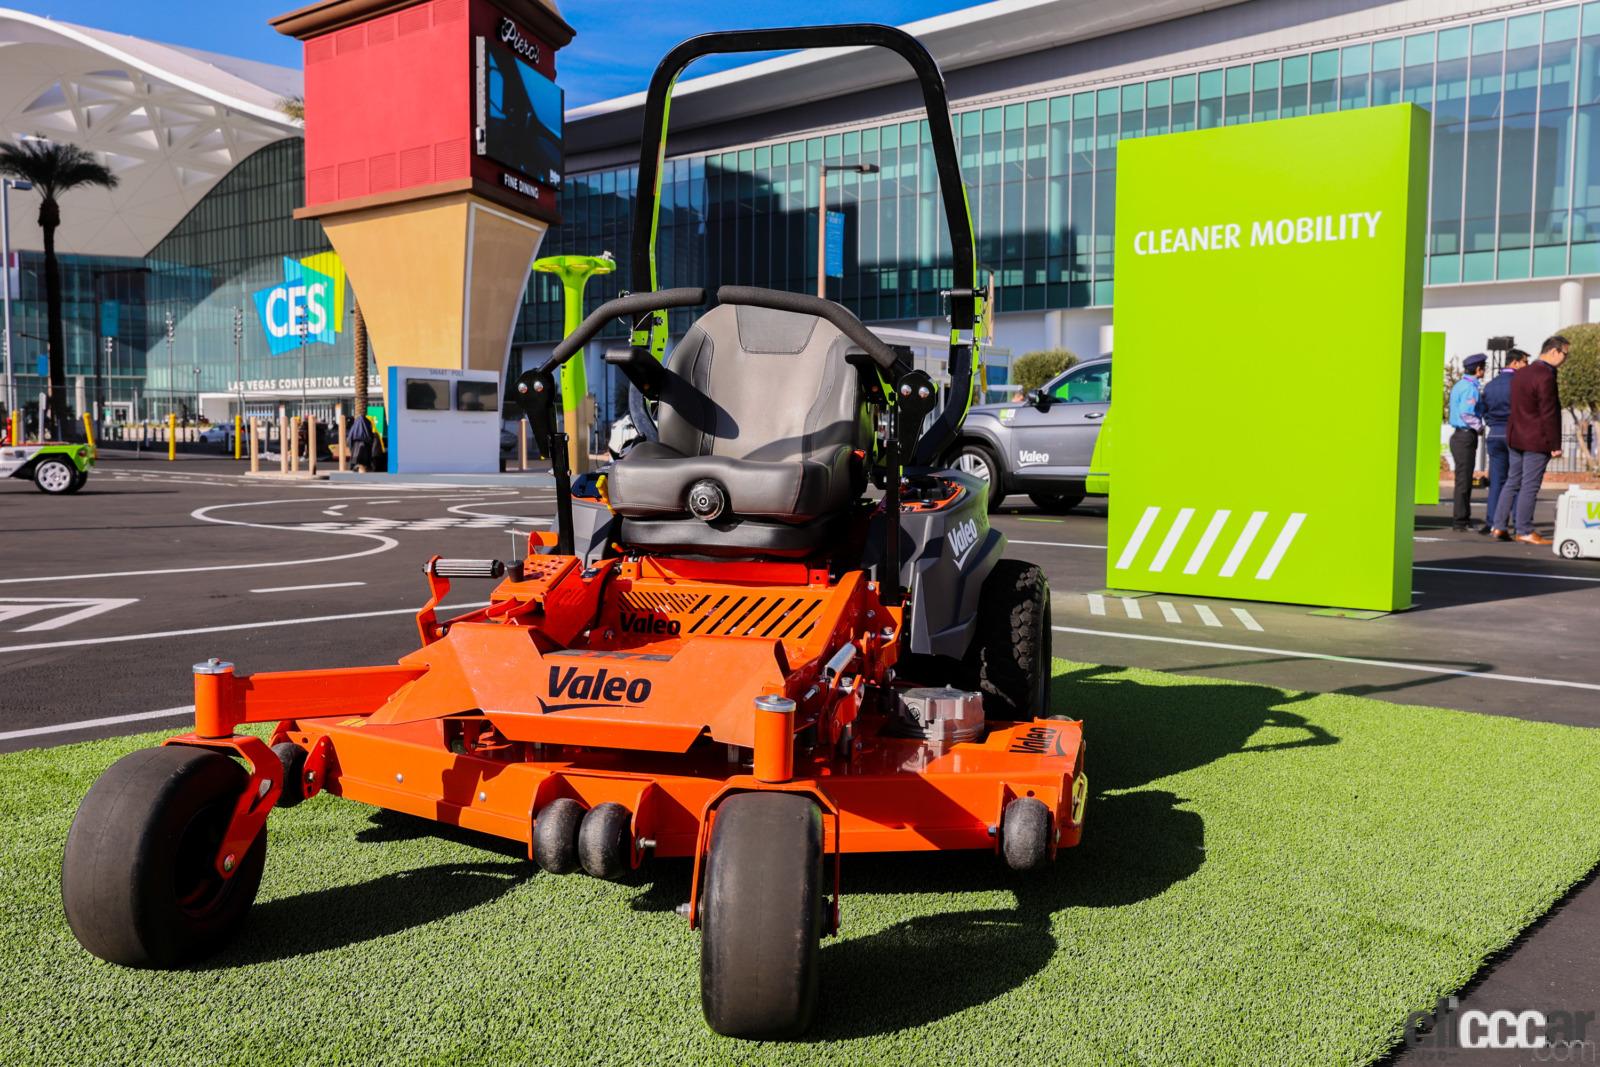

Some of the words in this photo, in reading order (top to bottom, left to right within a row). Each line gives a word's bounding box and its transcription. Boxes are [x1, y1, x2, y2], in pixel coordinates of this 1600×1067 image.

[500, 17, 541, 65] Piero's
[504, 173, 518, 190] FINE
[519, 180, 540, 199] DINING
[1133, 222, 1241, 256] CLEANER
[1250, 210, 1383, 247] MOBILITY
[265, 282, 327, 338] CES
[228, 381, 244, 391] LAS
[247, 379, 276, 390] VEGAS
[279, 376, 340, 389] CONVENTION
[343, 375, 382, 387] CEER
[1019, 450, 1050, 463] Valeo
[947, 518, 978, 558] Valeo
[620, 612, 681, 636] Valeo
[548, 665, 652, 703] Valeo
[1008, 727, 1058, 755] Valeo
